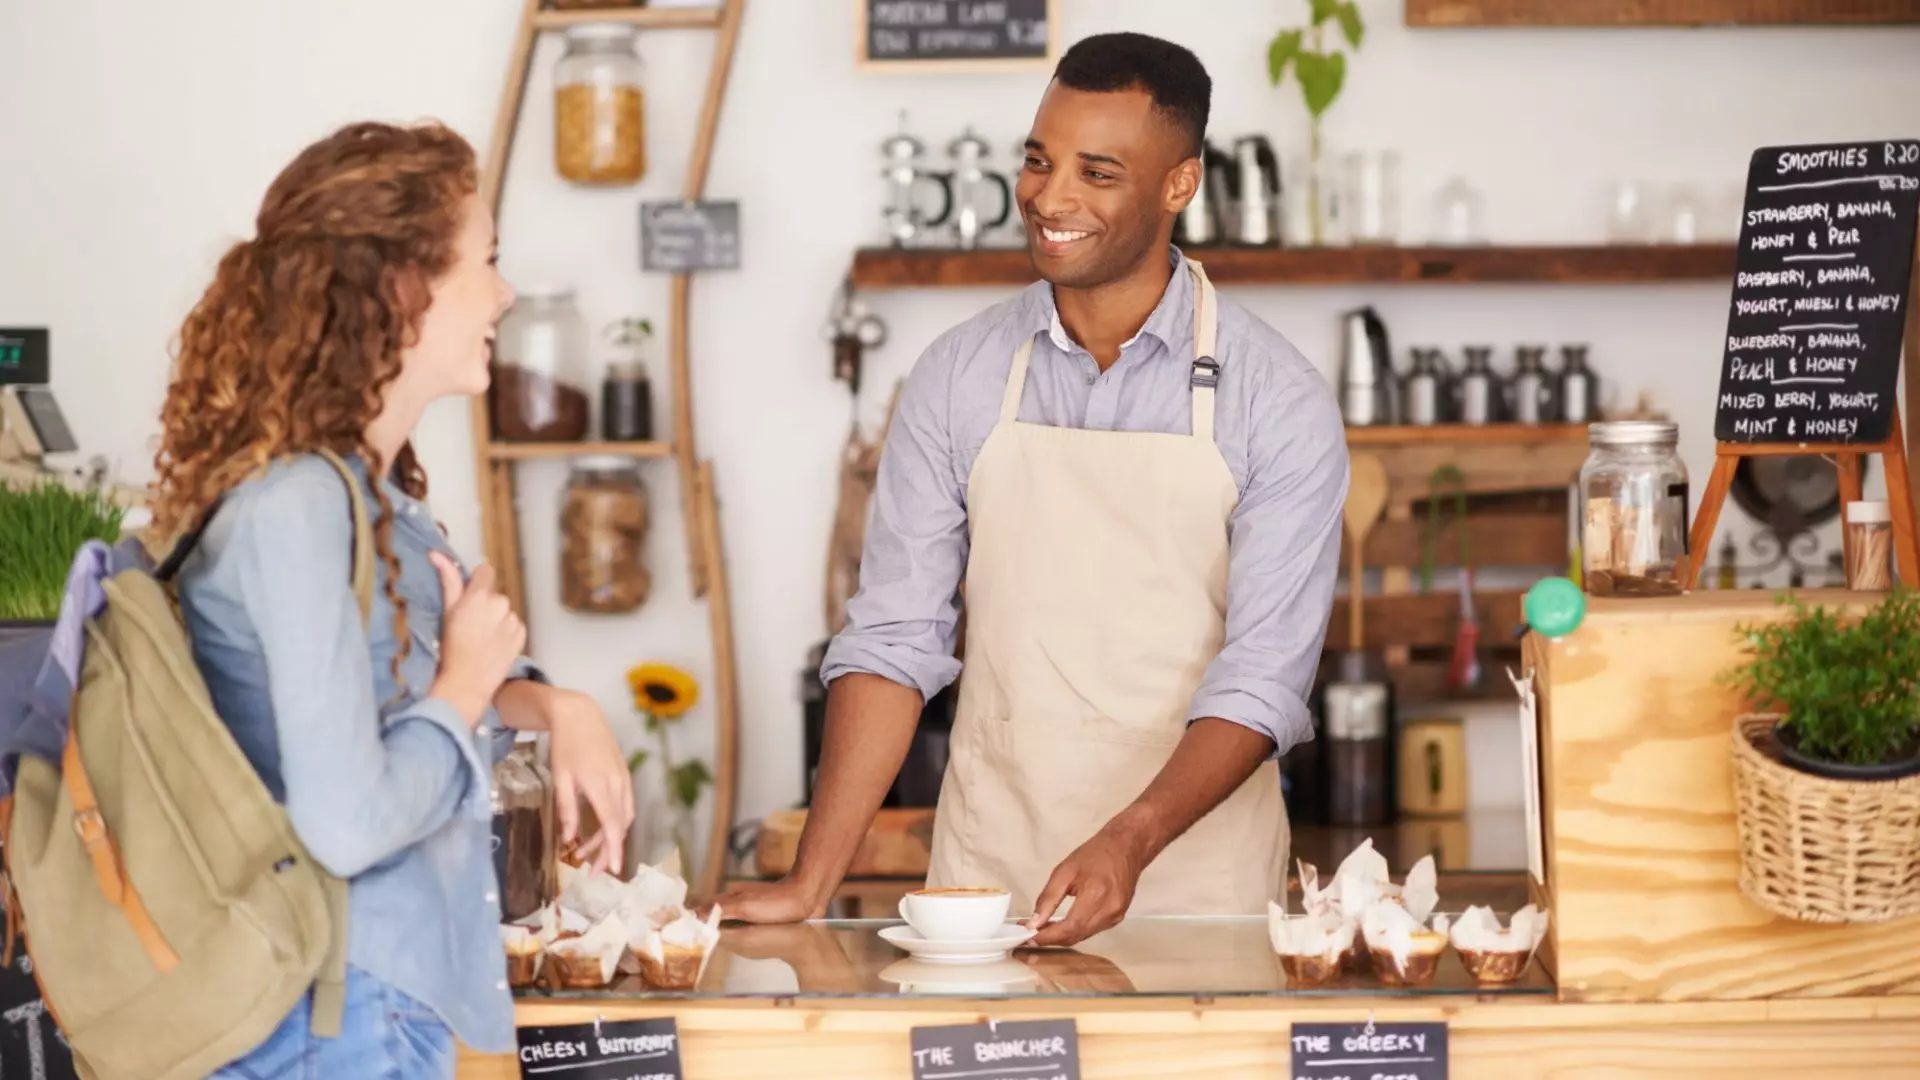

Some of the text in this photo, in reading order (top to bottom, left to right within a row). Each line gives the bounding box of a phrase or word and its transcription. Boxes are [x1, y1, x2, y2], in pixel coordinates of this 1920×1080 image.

[1777, 142, 1920, 174] SMOOTHIES R20
[1747, 200, 1896, 226] STRAWBERRY, BANANA,
[1751, 226, 1861, 250] HONEY & PEAR
[1737, 264, 1875, 289] RASPBERRY, BANANA,
[1736, 294, 1900, 317] YOGURT, MUESLI & HONEY
[1728, 332, 1867, 355] BLUEBERRY, BANANA,
[1730, 356, 1858, 381] PEACH & HONEY
[1719, 390, 1880, 412] MIXED BERRY, YOGURT,
[1734, 416, 1859, 436] MINT & HONEY
[520, 1041, 588, 1063] CHEESY
[913, 1036, 1067, 1069] THE BRUNCHER
[1292, 1035, 1331, 1054] THE
